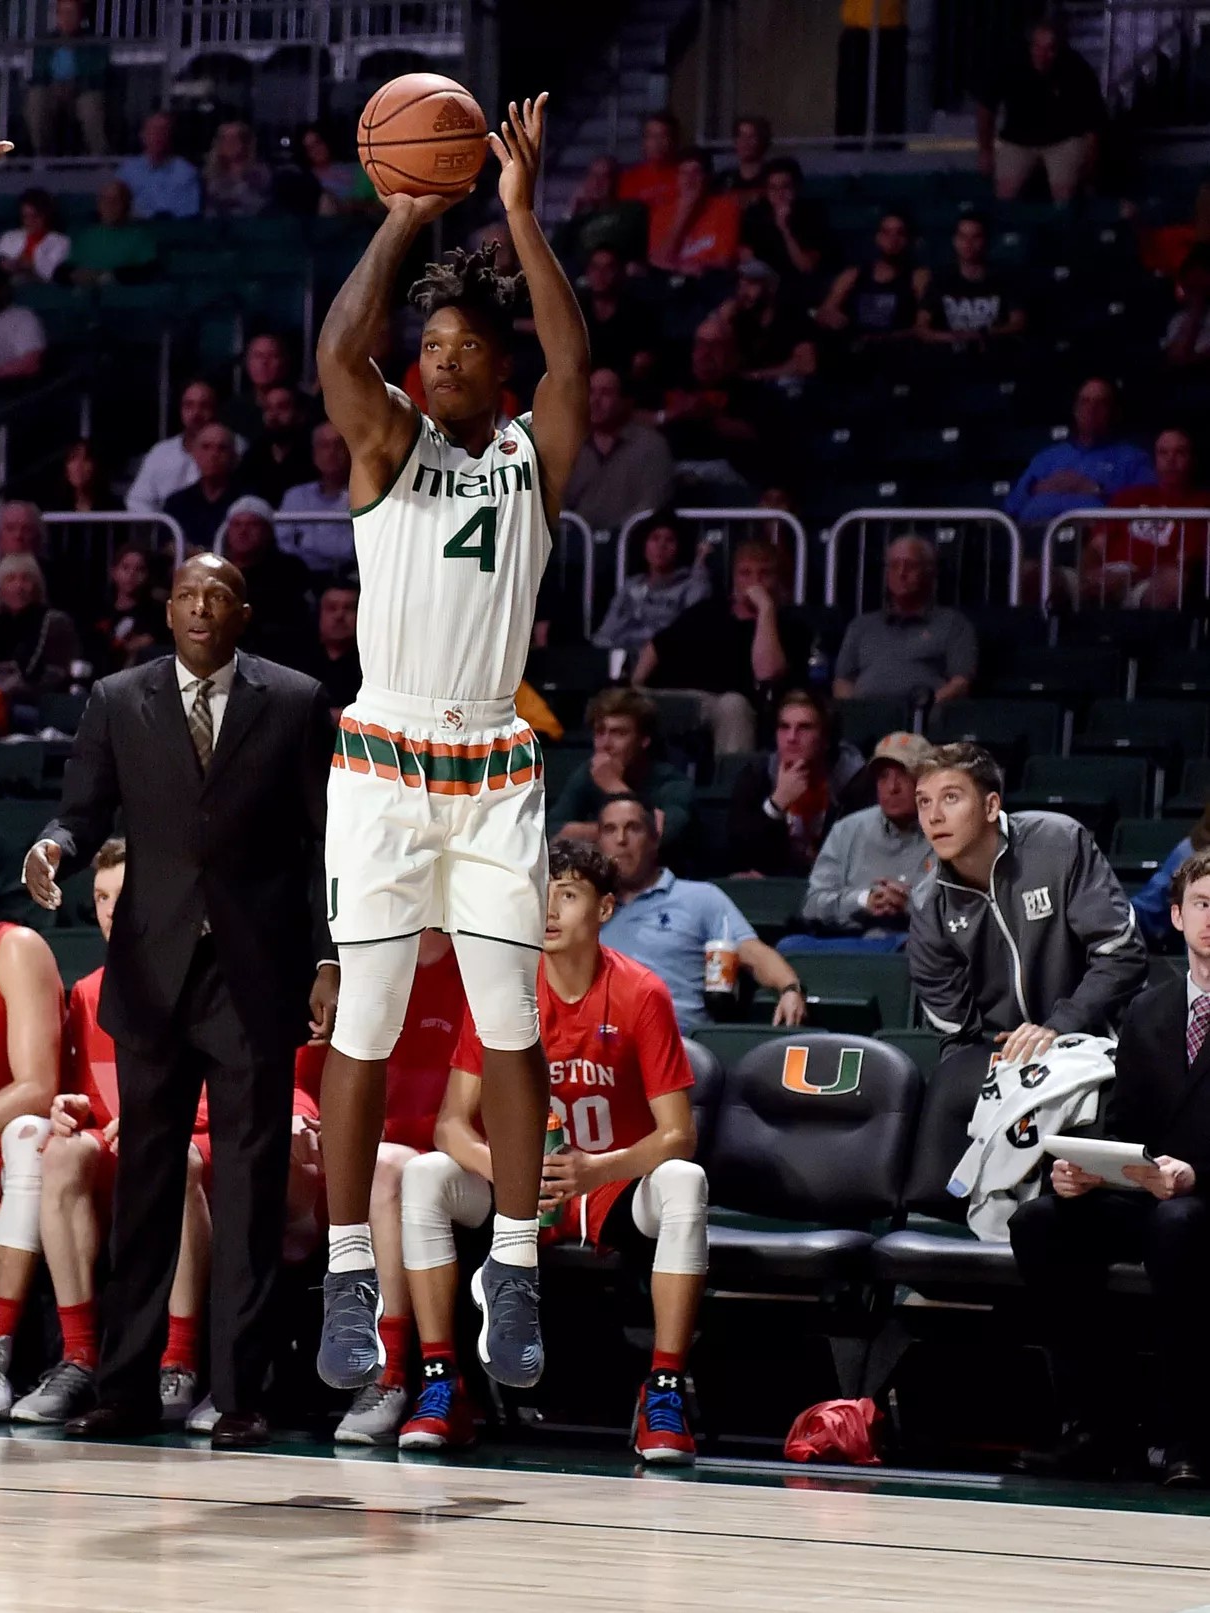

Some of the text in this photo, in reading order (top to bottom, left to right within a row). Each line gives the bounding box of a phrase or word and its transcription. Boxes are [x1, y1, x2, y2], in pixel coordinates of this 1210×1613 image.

[443, 506, 497, 573] 4
[549, 1058, 616, 1087] STON
[782, 1046, 864, 1095] U
